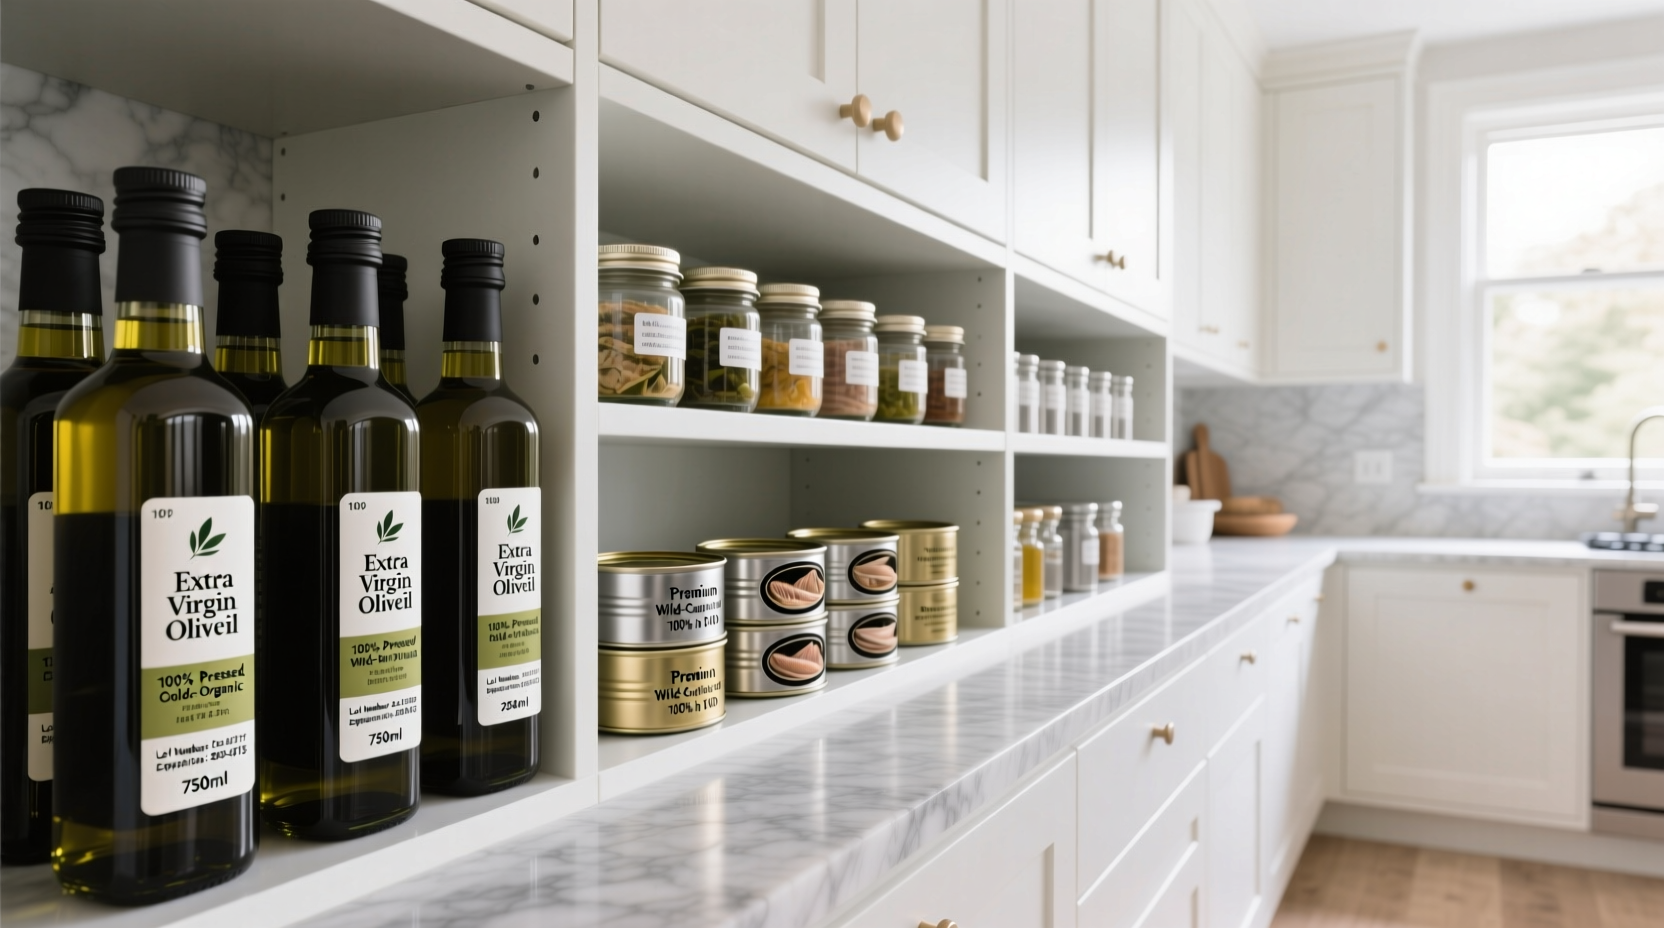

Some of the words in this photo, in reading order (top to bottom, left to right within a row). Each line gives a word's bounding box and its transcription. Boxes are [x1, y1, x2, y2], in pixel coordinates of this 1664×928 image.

[498, 544, 532, 559] Extra
[364, 554, 408, 571] Extra
[493, 560, 535, 580] Virgin
[173, 571, 234, 593] Extra
[359, 573, 412, 594] Virgin
[493, 576, 535, 596] Oliveil
[669, 584, 717, 600] Premium
[166, 592, 238, 619] Virgin
[359, 591, 412, 614] Oliveil
[166, 613, 238, 641] Oliveil
[157, 672, 194, 688] 100%
[182, 770, 228, 794] 750ml
